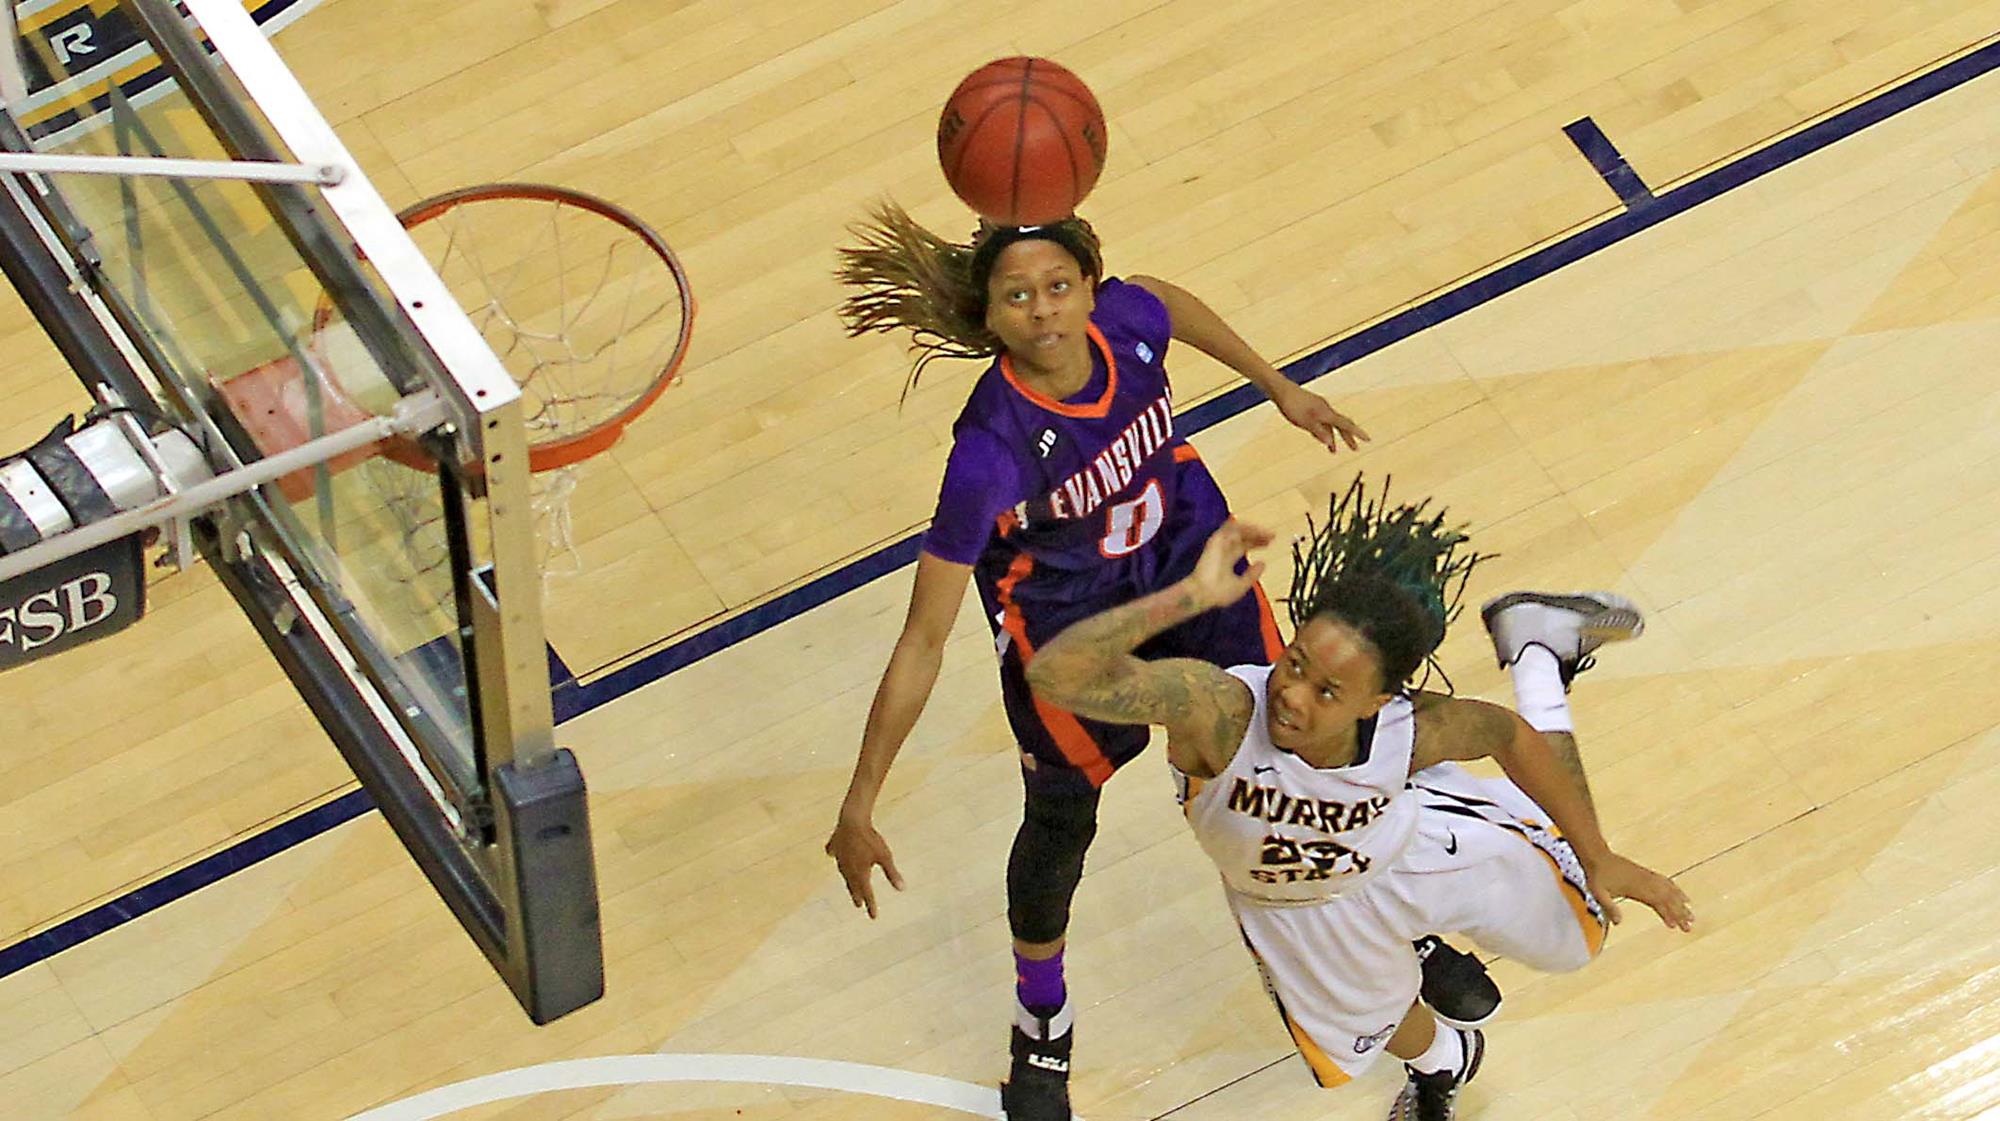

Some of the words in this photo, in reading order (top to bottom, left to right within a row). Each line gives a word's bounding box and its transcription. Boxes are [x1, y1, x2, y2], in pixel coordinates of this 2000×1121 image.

[1050, 386, 1174, 519] EVANSVILL
[1099, 478, 1166, 559] 0
[1228, 775, 1392, 834] MURRAY
